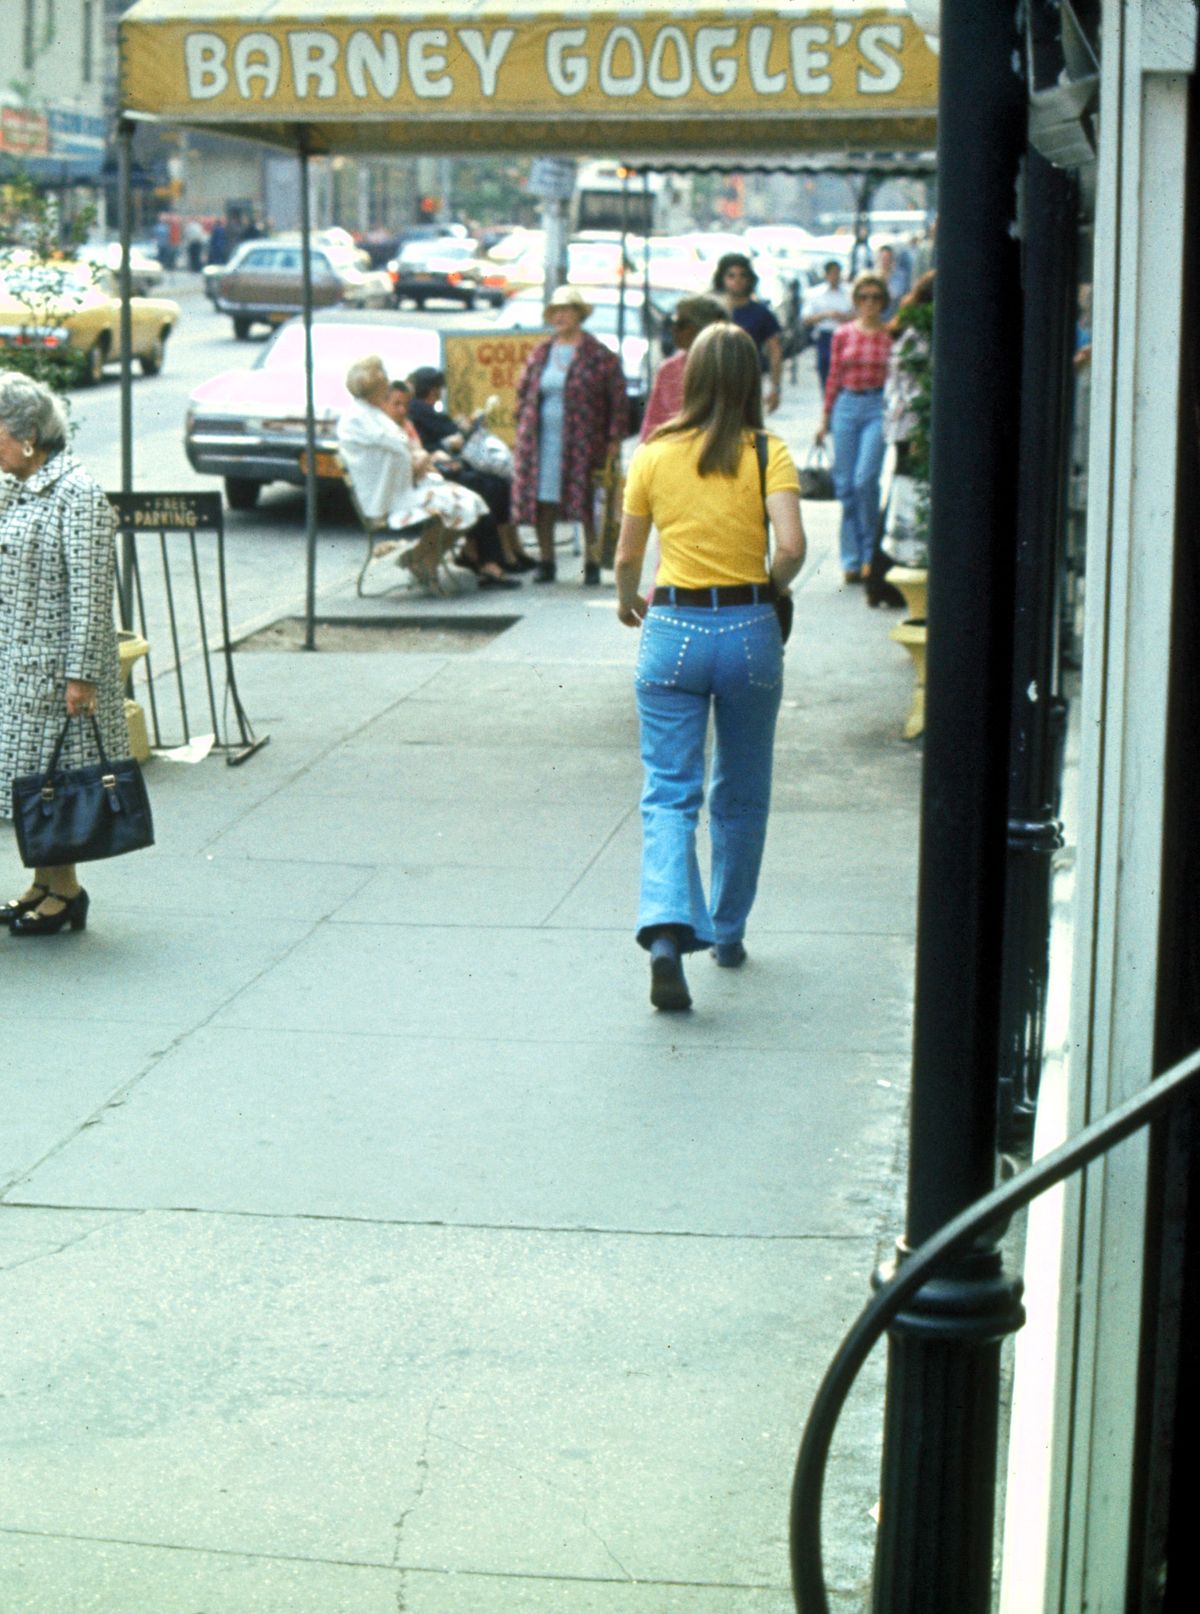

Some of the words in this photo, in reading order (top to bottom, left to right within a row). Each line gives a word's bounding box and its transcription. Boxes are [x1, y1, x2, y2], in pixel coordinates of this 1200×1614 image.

[185, 28, 516, 100] BARNEY
[545, 22, 903, 98] GOOGLE'S
[154, 497, 188, 512] FREE
[133, 511, 198, 528] PARKING
